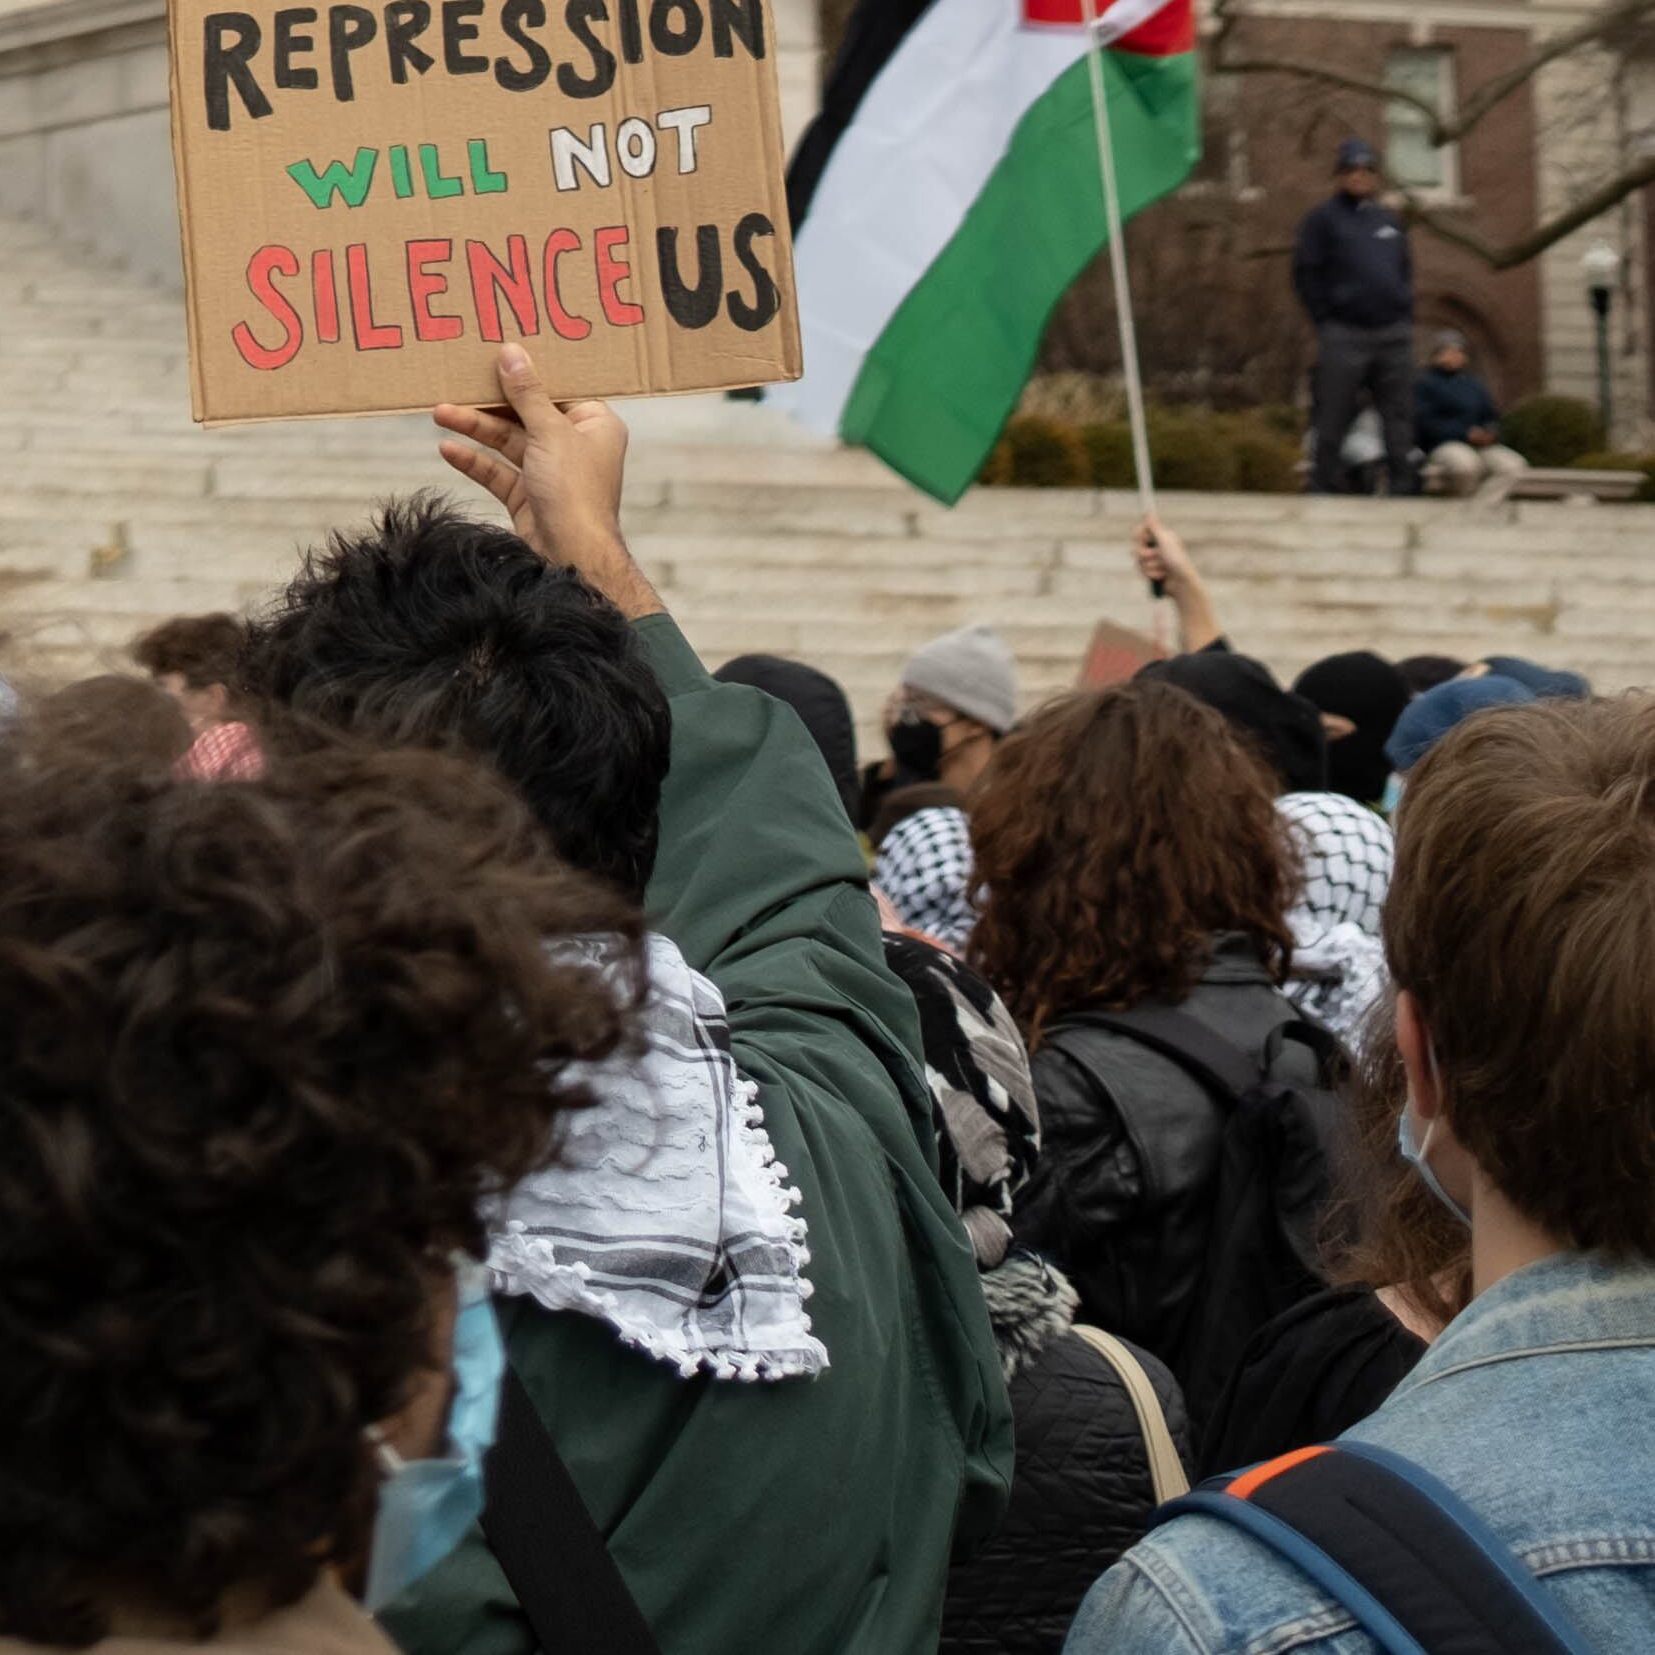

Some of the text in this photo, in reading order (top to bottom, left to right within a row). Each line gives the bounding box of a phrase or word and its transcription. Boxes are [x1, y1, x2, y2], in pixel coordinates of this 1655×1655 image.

[286, 104, 712, 210] WILL NOT
[231, 212, 781, 370] SILENCE US
